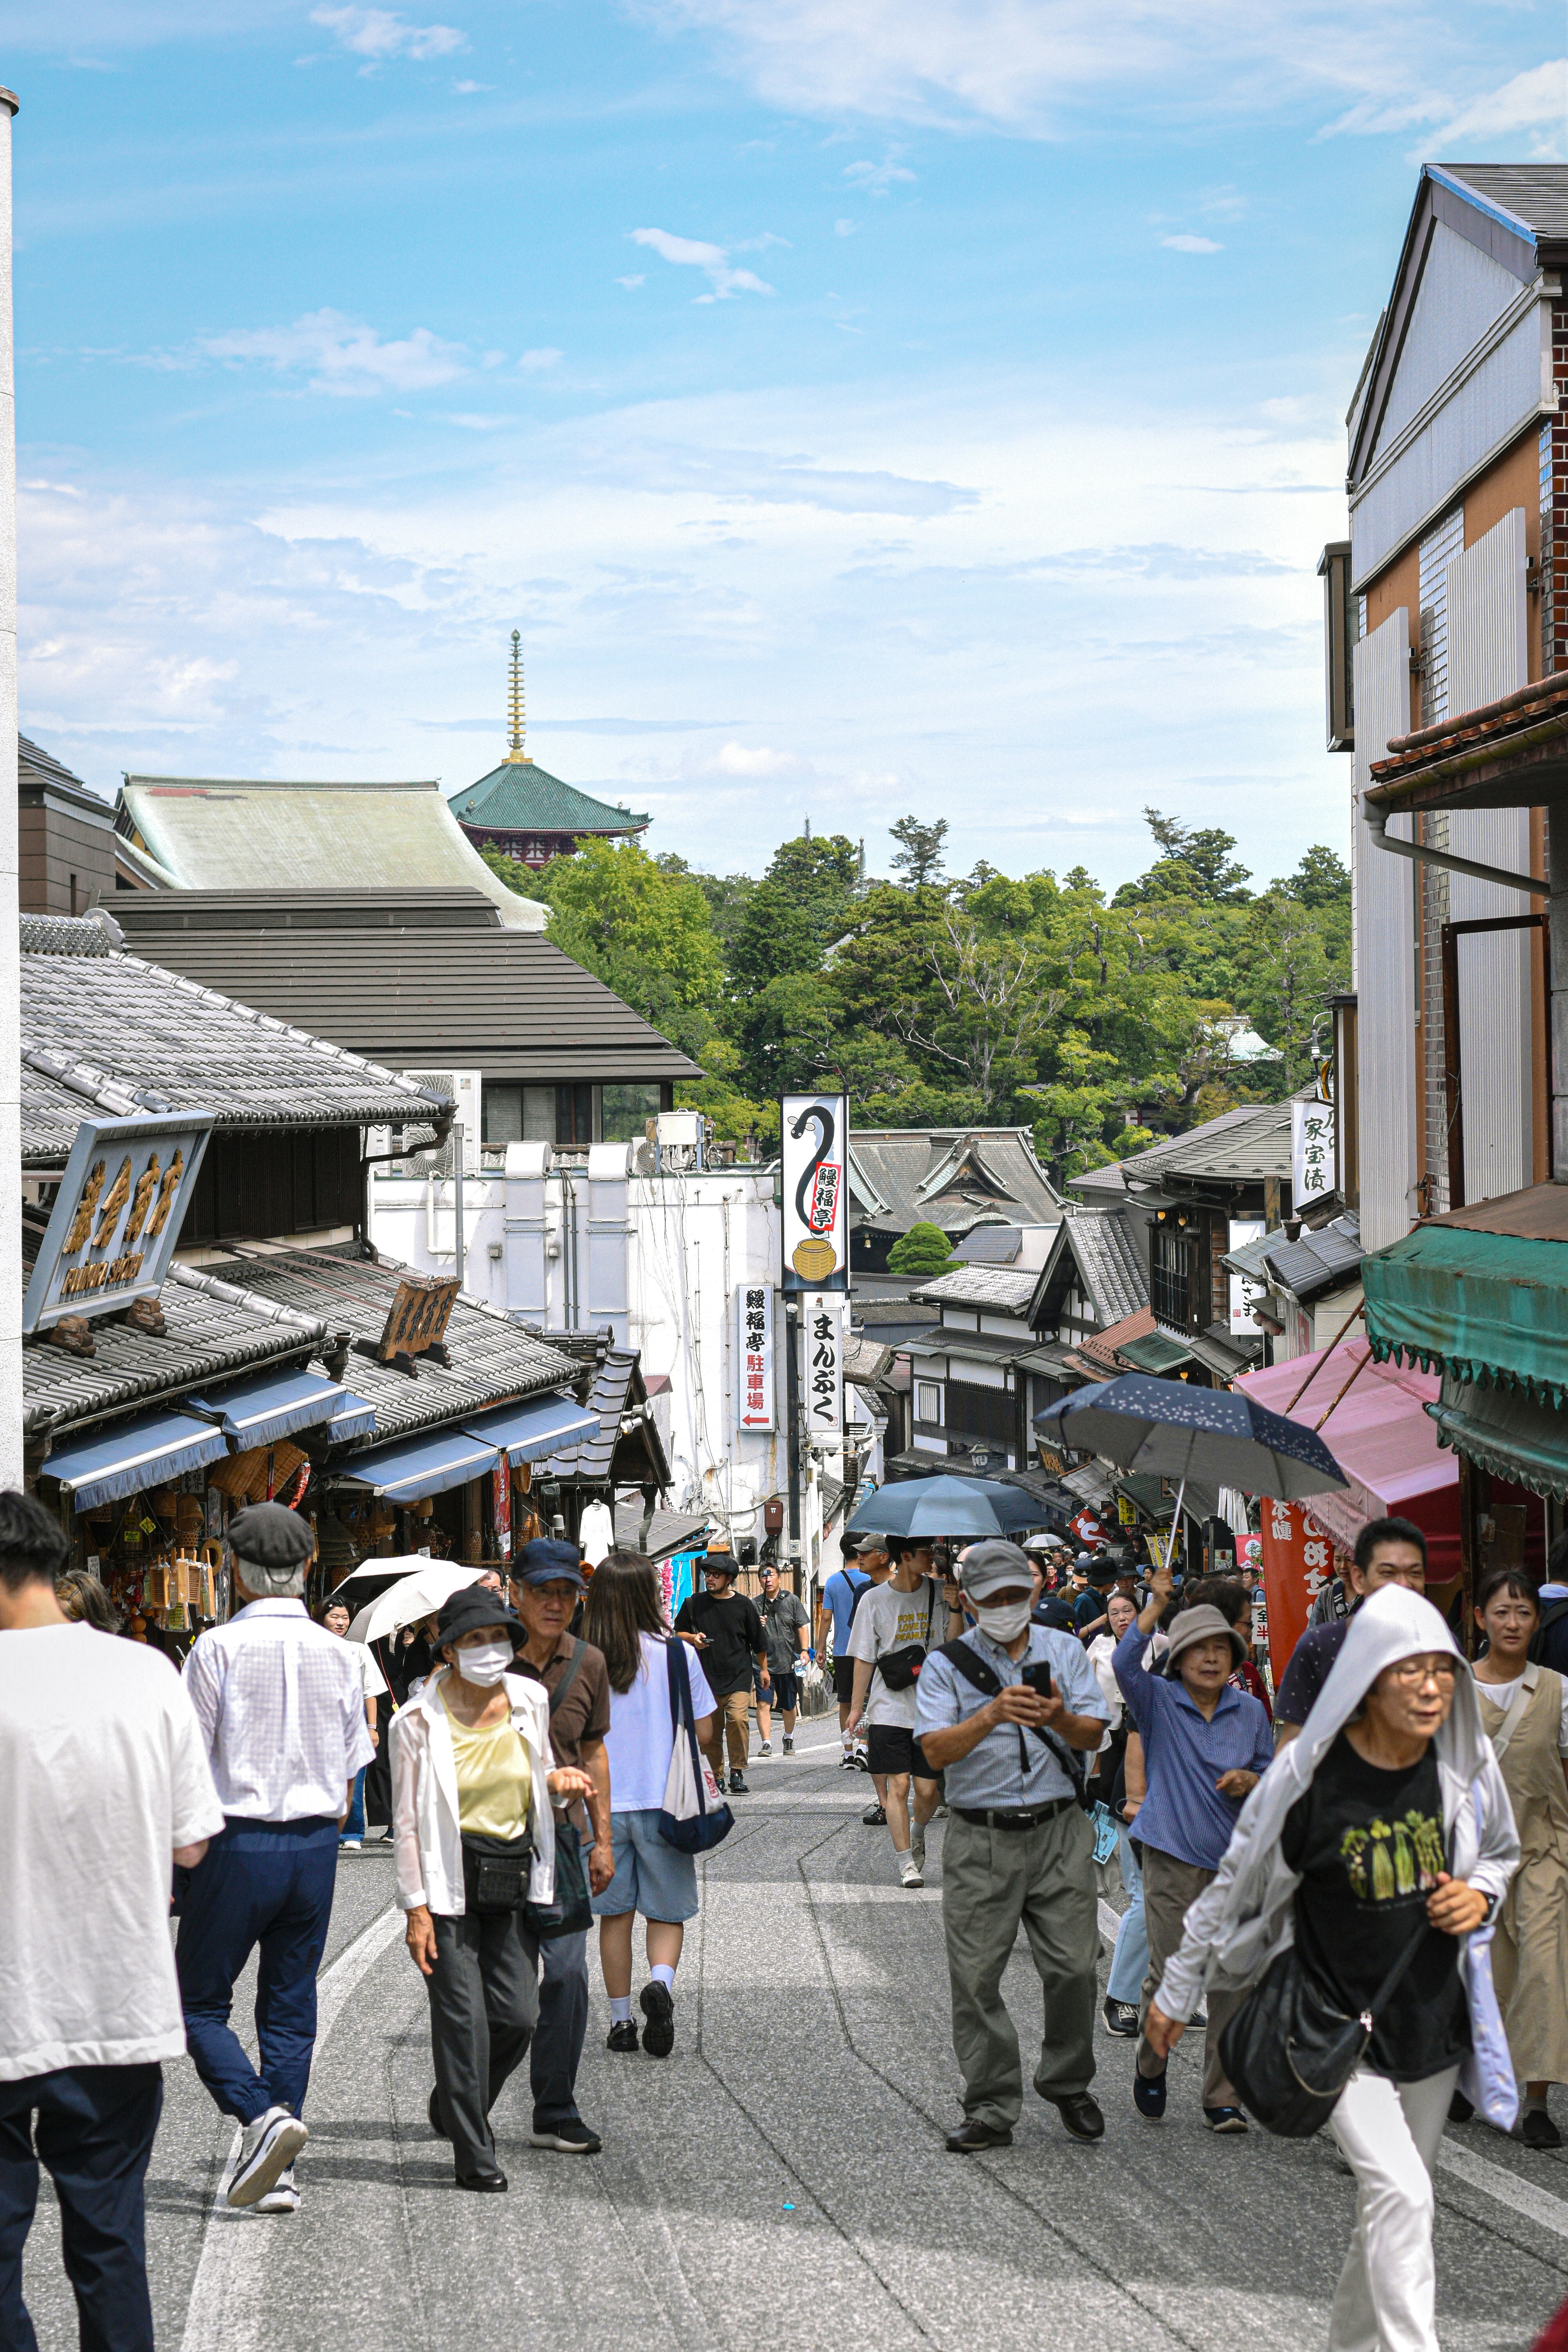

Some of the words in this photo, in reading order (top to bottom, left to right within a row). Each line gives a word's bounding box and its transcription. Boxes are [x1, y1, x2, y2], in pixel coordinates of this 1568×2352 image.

[1304, 1117, 1327, 1191] 家宝漬
[814, 1167, 837, 1227] 鰻福亭
[811, 1314, 835, 1422] まんぷく
[898, 1613, 914, 1623] FOR
[916, 1612, 933, 1621] TH
[899, 1622, 919, 1632] LOVE
[895, 1630, 935, 1642] PEANUT!
